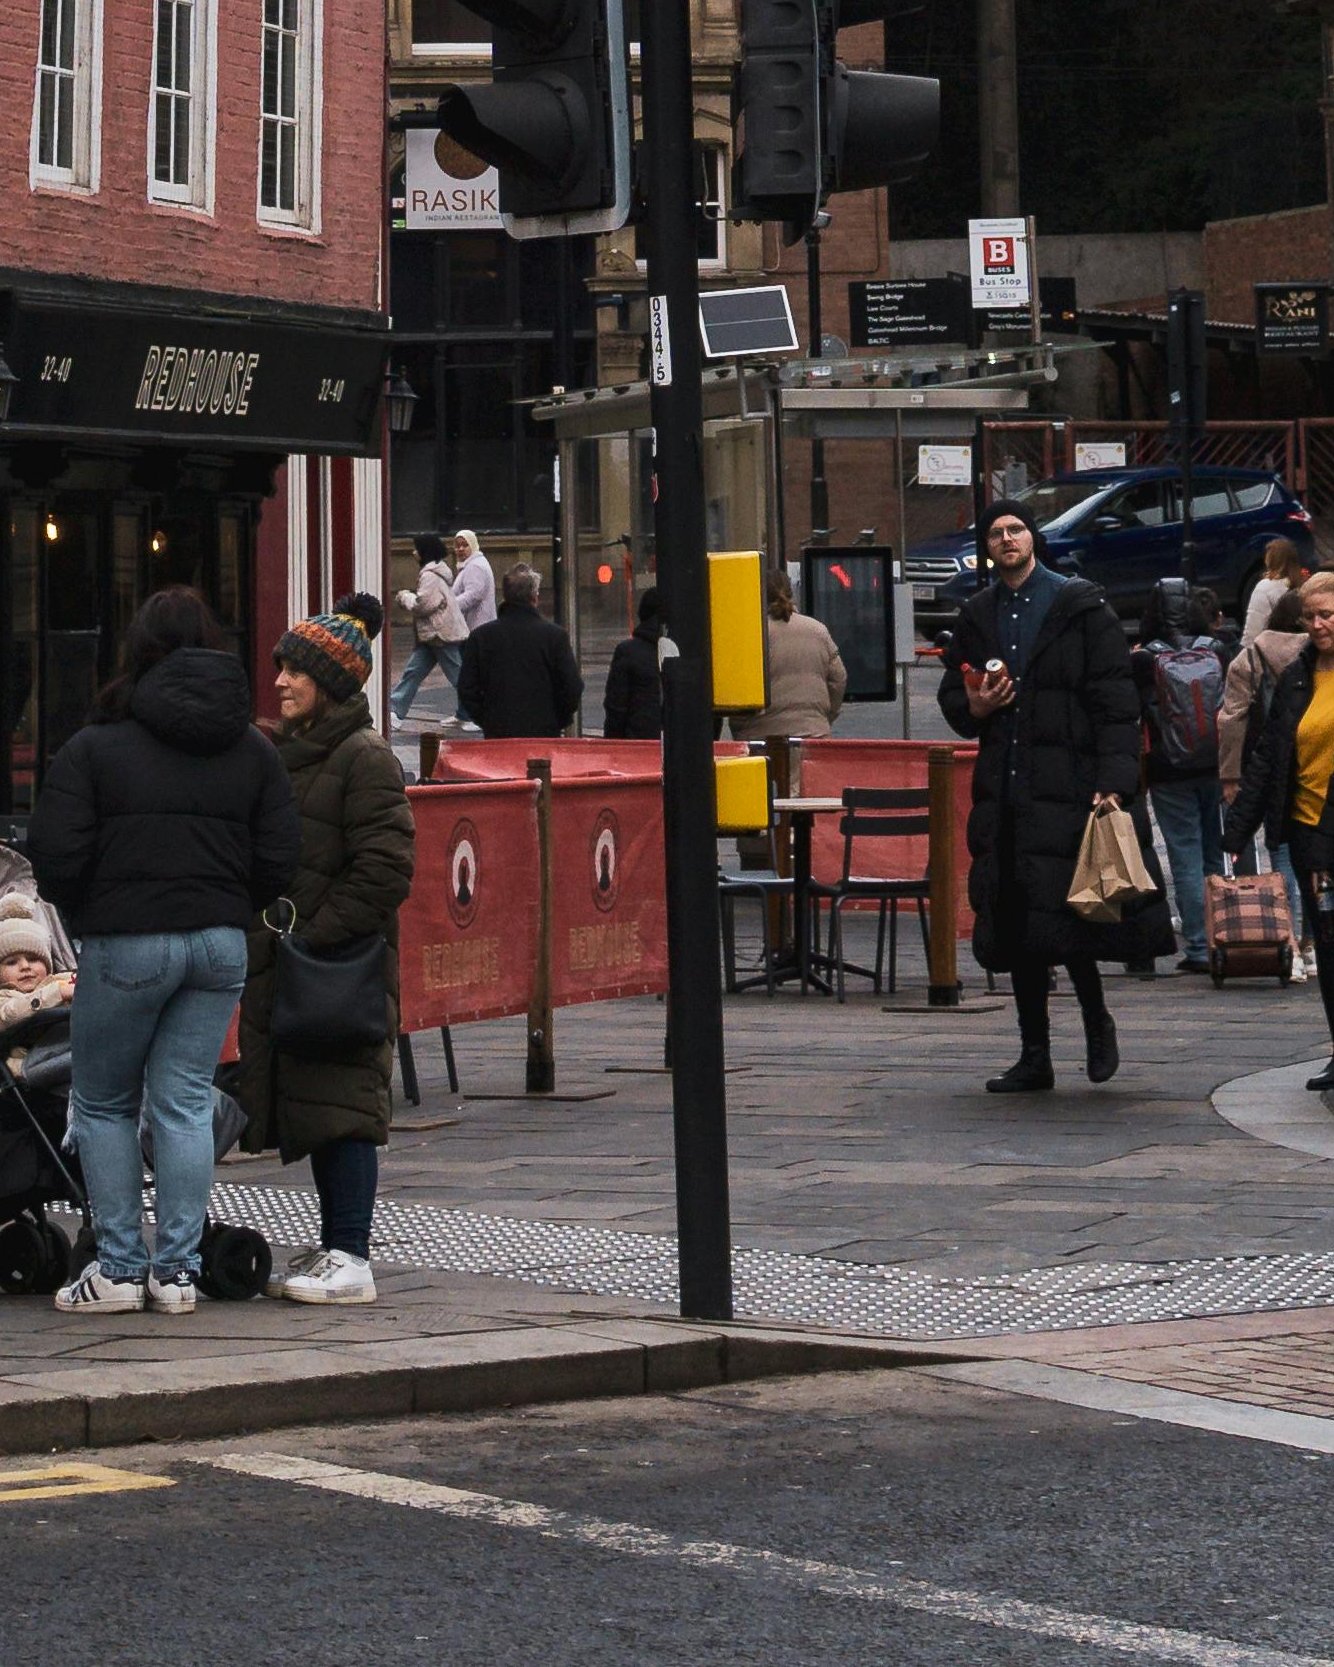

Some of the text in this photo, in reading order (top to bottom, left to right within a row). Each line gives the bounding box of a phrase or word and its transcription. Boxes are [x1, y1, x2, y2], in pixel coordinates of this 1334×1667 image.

[454, 213, 500, 221] RESTAURAN
[989, 240, 1009, 263] B
[979, 277, 1022, 286] Bus Stop
[40, 345, 345, 416] 32-40 REDHOUSE 32-40
